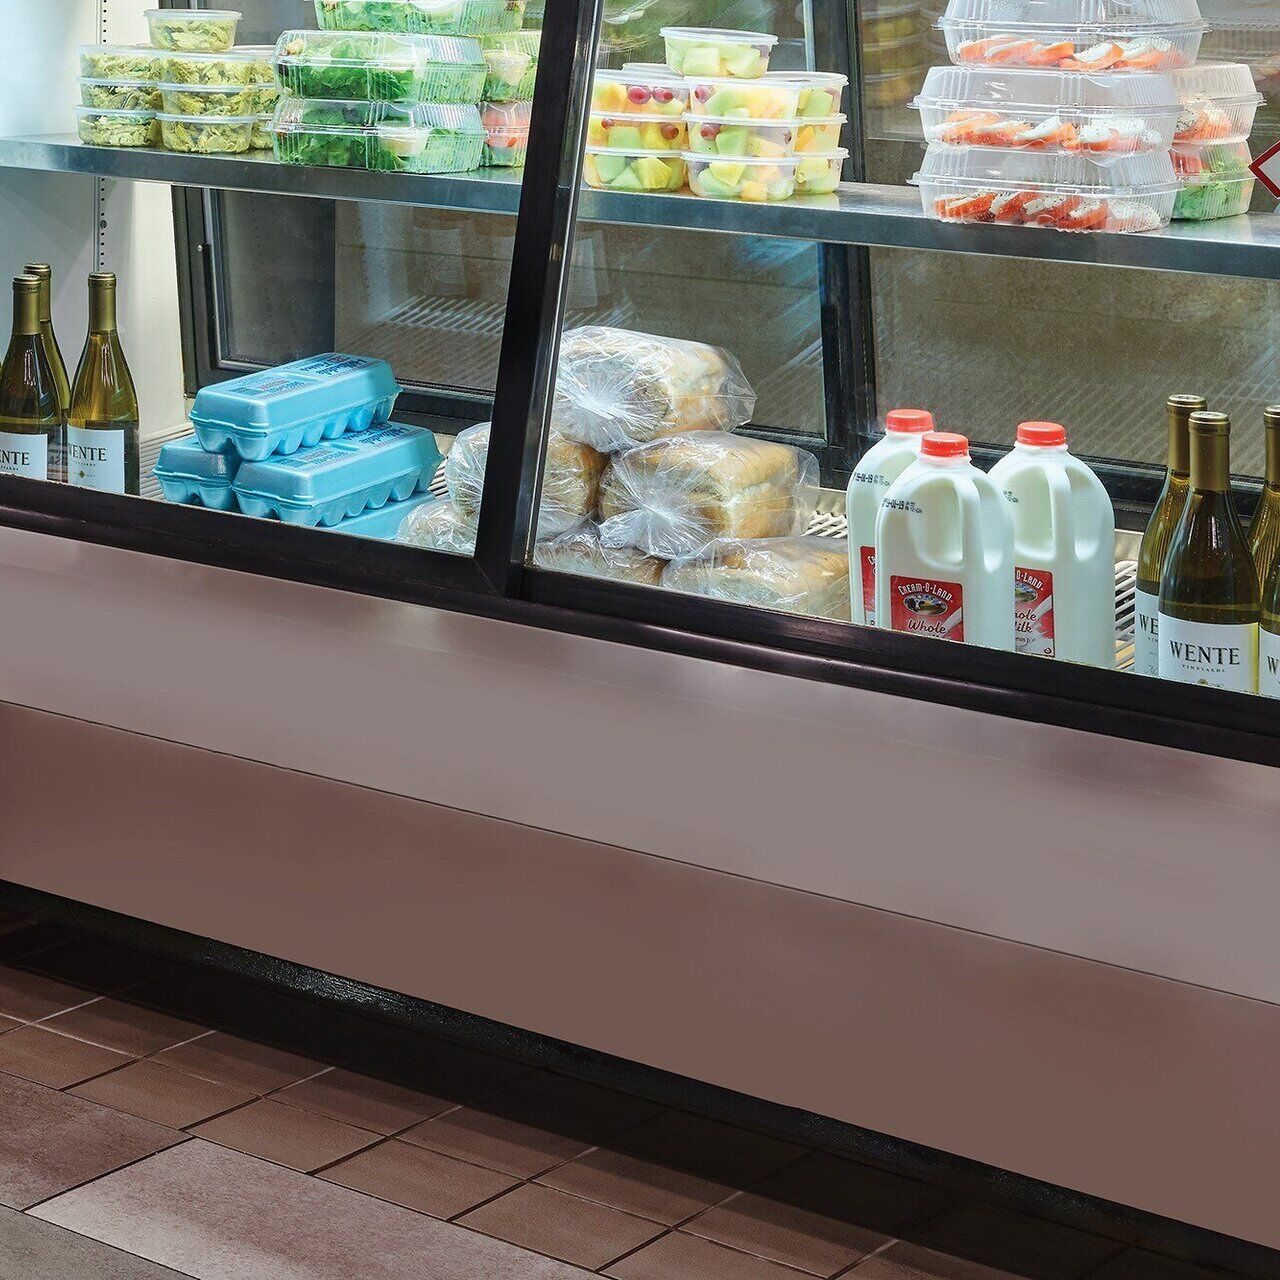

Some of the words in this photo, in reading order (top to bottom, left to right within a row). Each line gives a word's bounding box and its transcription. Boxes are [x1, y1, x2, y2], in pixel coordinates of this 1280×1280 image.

[907, 619, 947, 634] Whole
[1169, 639, 1240, 666] WENTE
[1182, 664, 1226, 673] VINEYARDS
